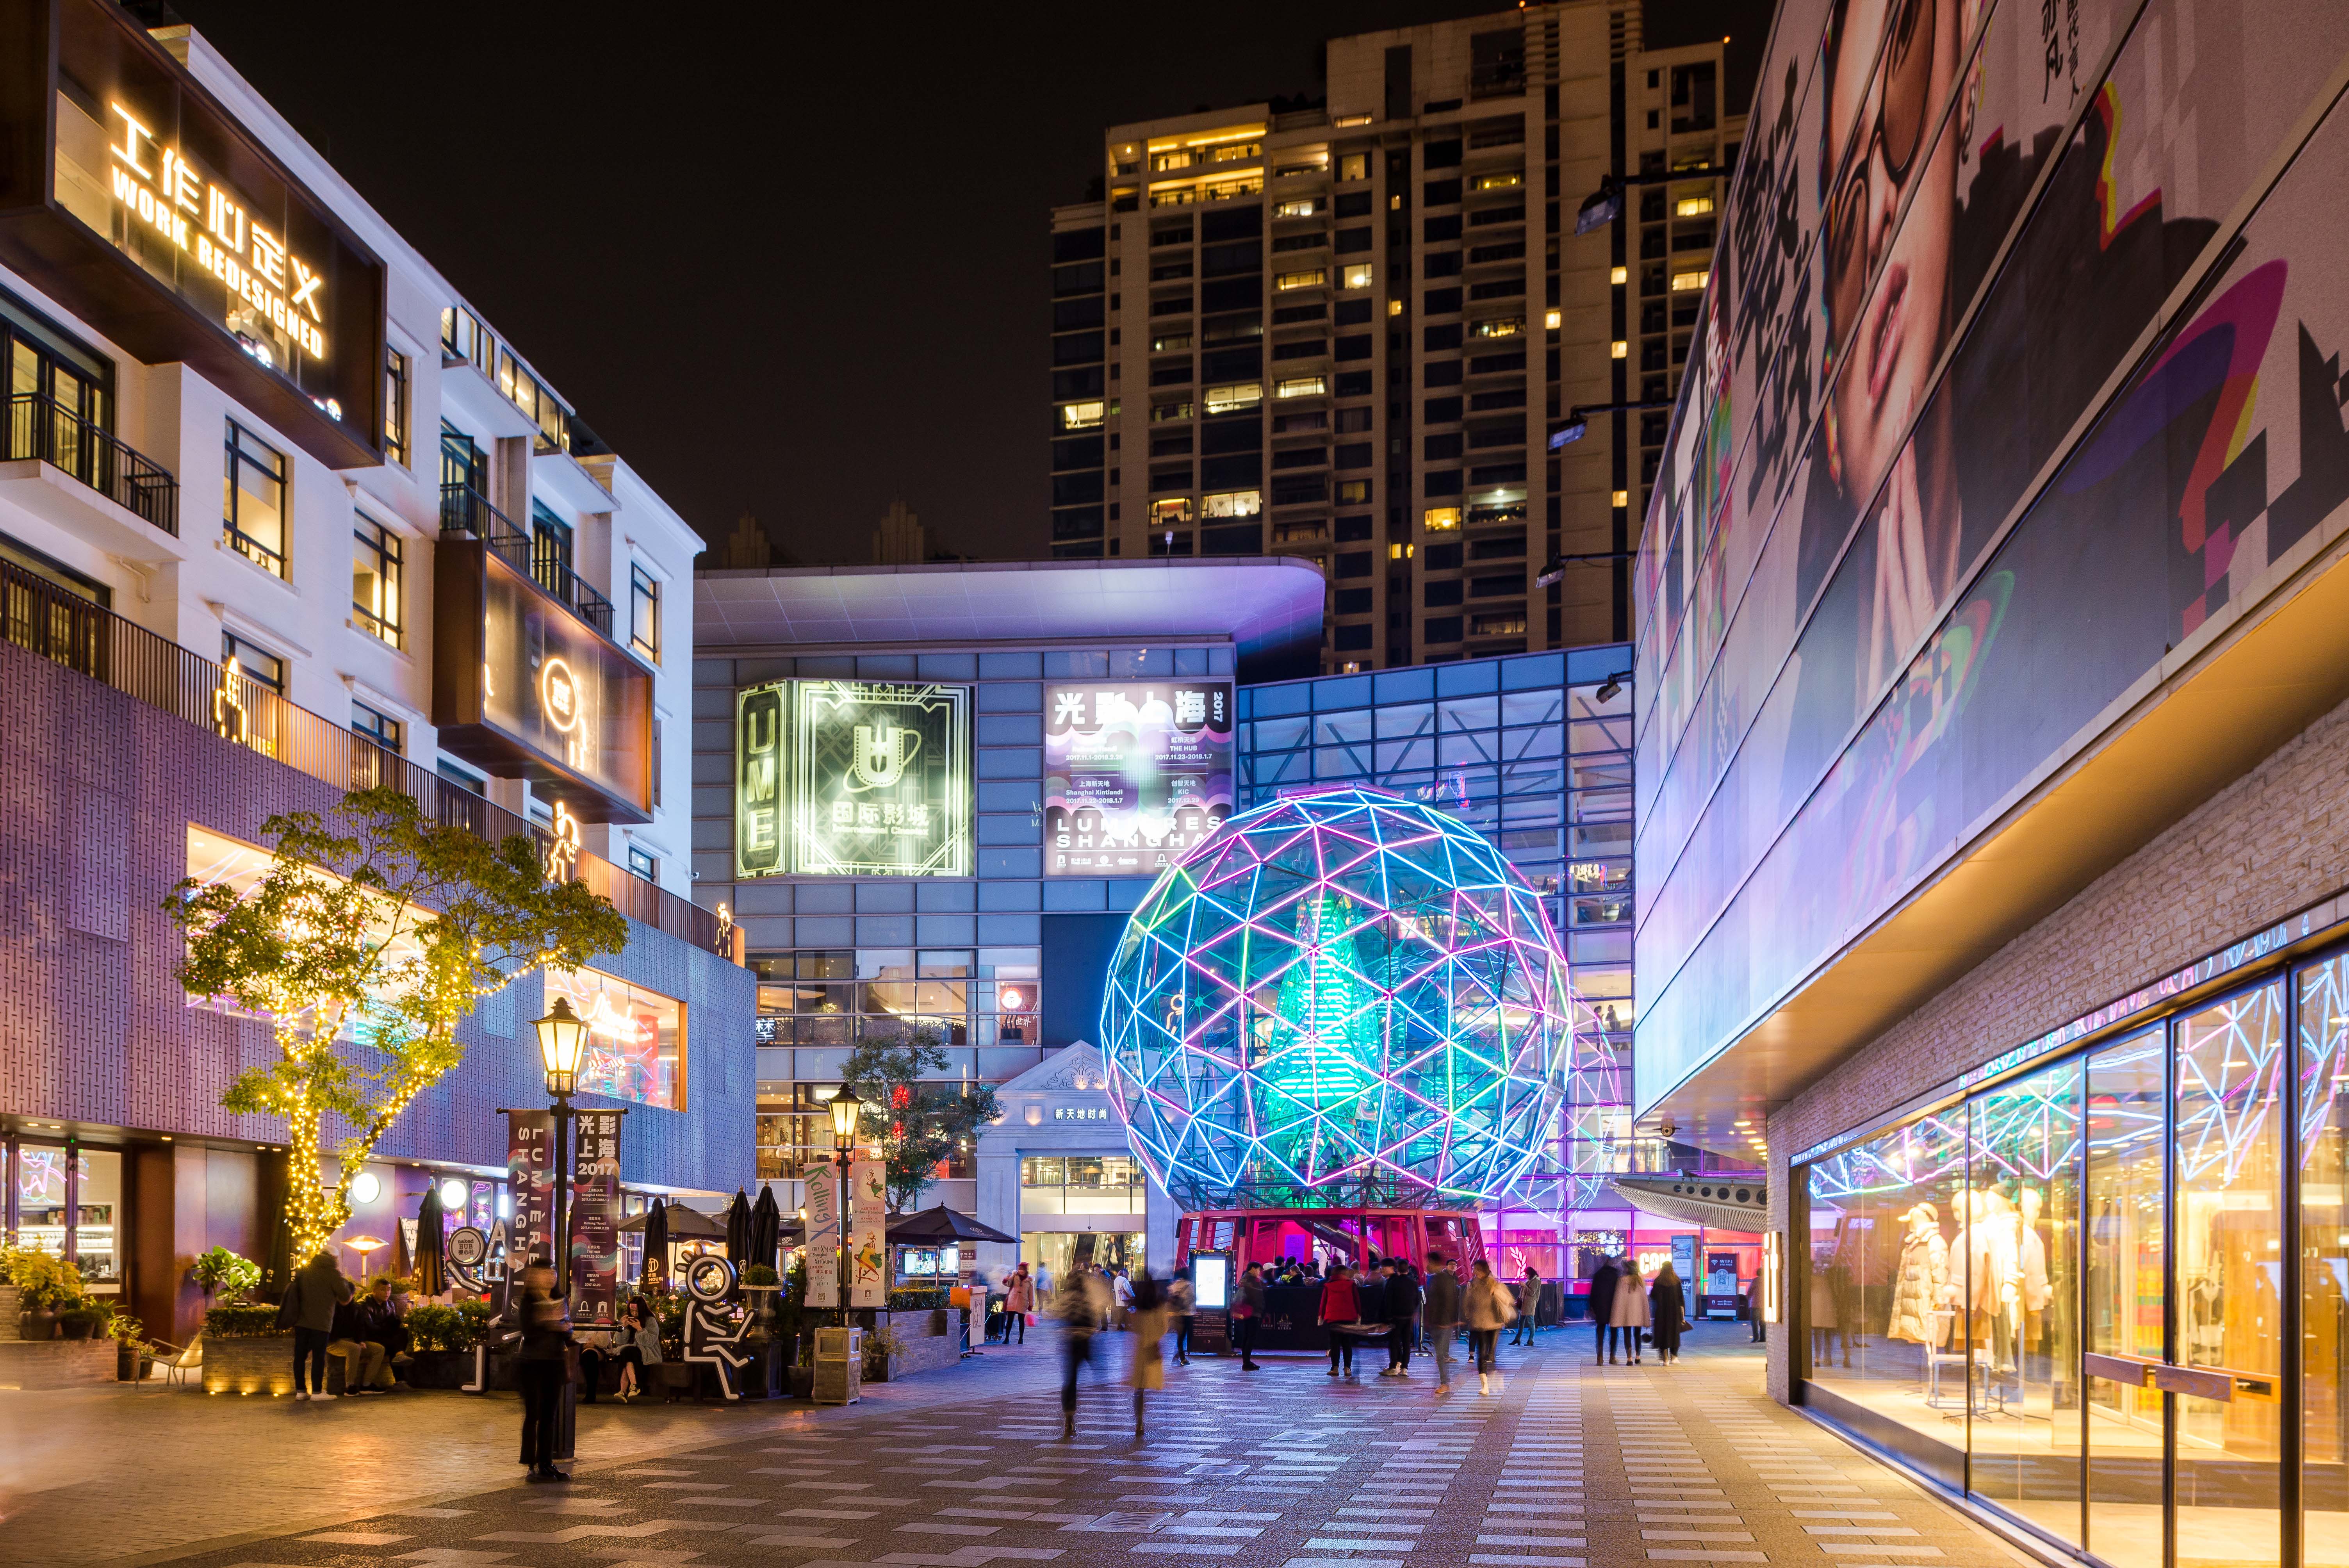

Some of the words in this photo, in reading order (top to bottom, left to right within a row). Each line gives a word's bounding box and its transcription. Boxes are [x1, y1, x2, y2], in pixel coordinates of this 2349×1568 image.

[111, 164, 188, 251] WORK
[198, 233, 323, 360] REDESIGNED
[1213, 691, 1223, 722] 2017
[747, 708, 776, 853] UME
[832, 801, 929, 826] 国际影城
[579, 1115, 616, 1134] 光影
[1055, 1108, 1107, 1119] 新天地时尚
[578, 1139, 615, 1157] 上海
[578, 1163, 615, 1175] 2017
[513, 1127, 530, 1285] SHANGHAI
[804, 1165, 832, 1223] Rolling
